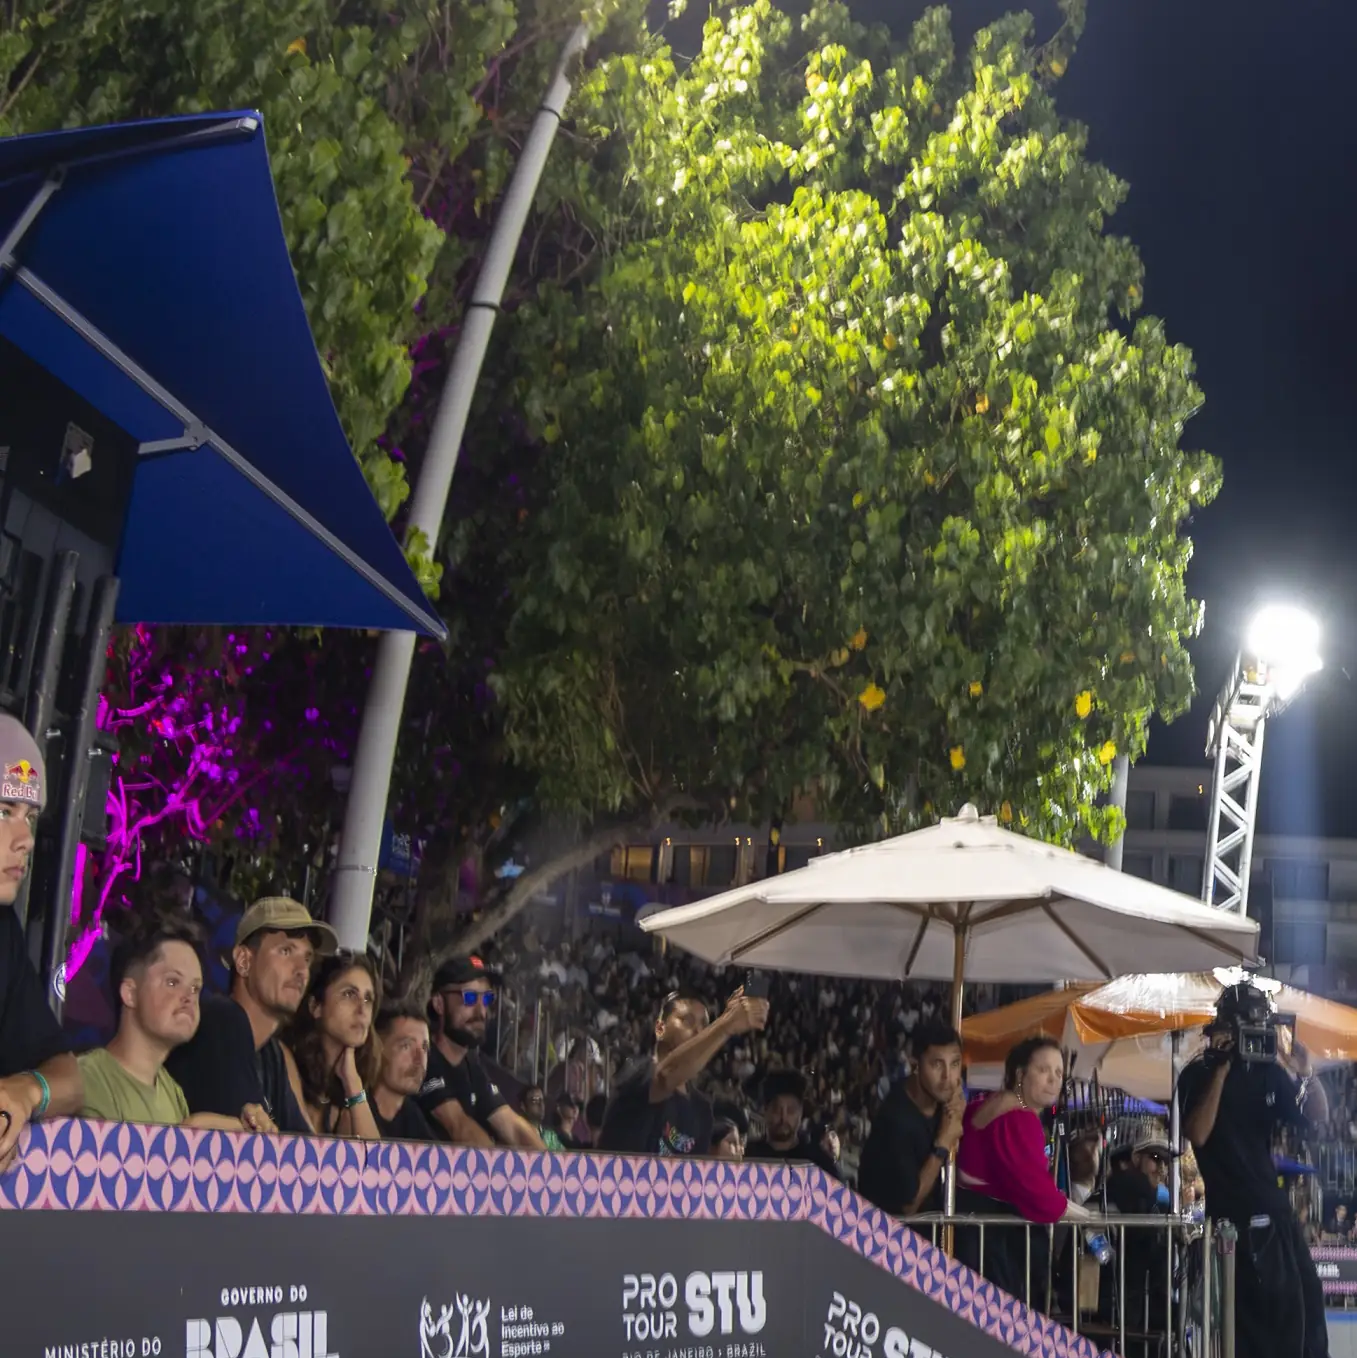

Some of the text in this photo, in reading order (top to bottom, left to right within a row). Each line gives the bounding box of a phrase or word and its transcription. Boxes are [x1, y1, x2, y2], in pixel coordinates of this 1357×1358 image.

[221, 1284, 308, 1306] GOVERNO DO
[623, 1272, 678, 1309] PRO
[501, 1304, 534, 1321] Lei de
[686, 1271, 767, 1337] STU
[501, 1321, 565, 1339] Incentivo ao
[623, 1311, 677, 1341] TOUR
[828, 1291, 880, 1345] PRO
[141, 1336, 163, 1358] DO
